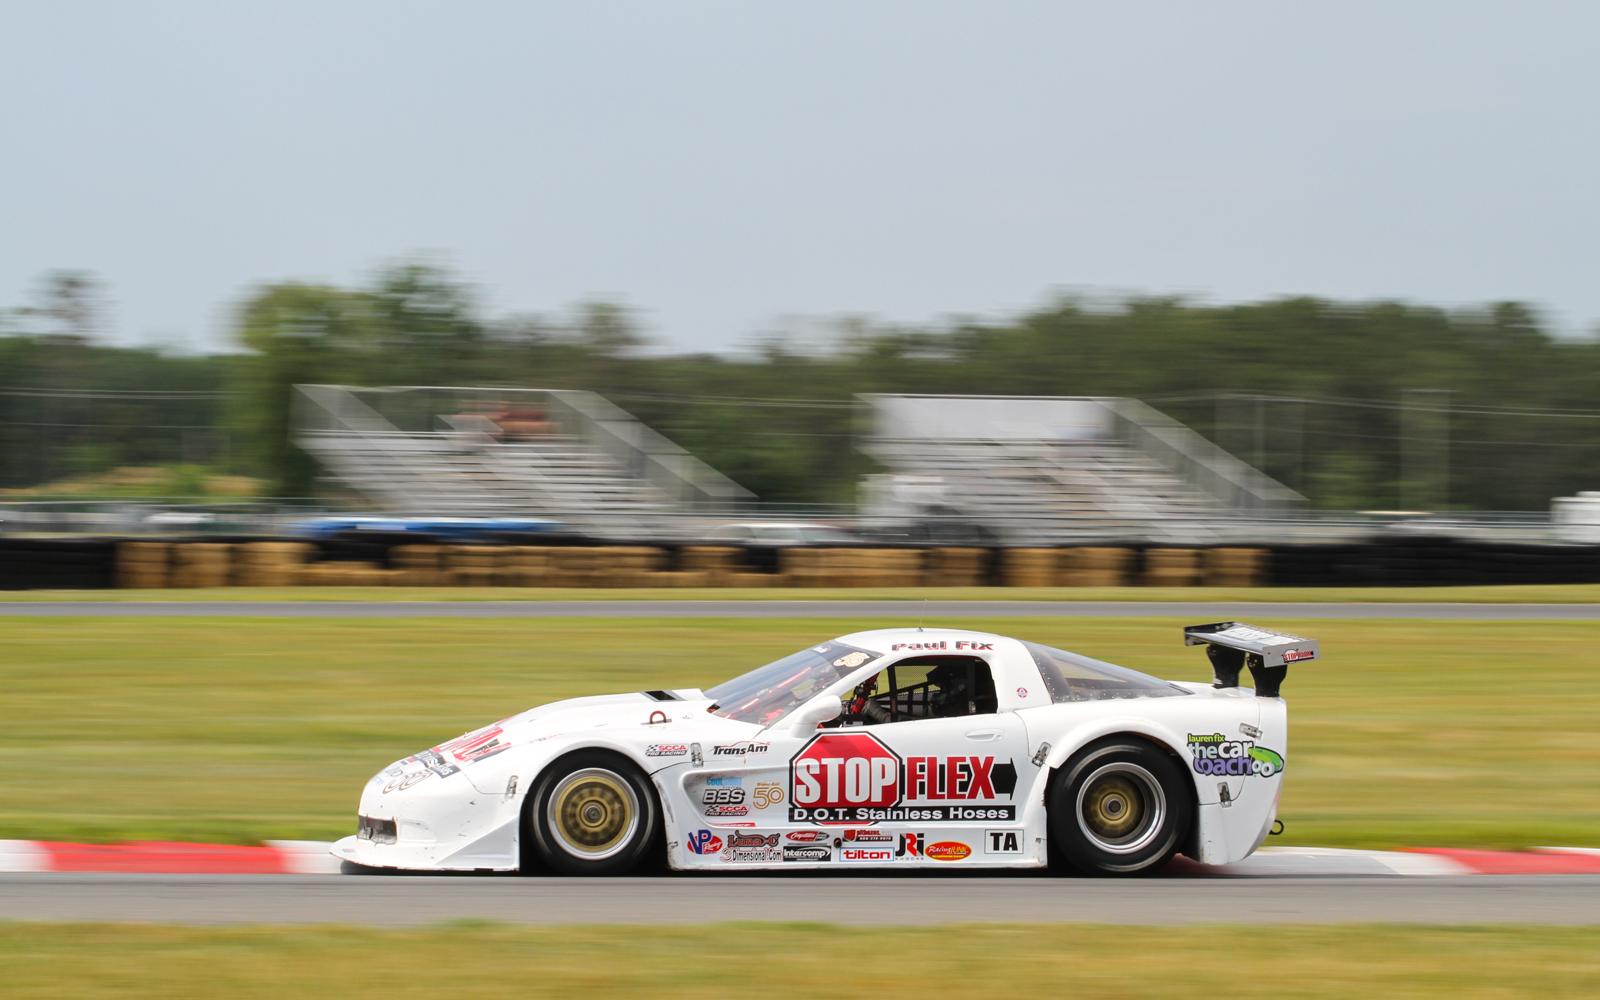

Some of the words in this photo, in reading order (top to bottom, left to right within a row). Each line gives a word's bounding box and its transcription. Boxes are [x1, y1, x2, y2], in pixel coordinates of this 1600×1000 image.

[891, 641, 947, 651] Paul
[955, 641, 994, 651] Fix
[1188, 733, 1214, 742] lauren
[1214, 733, 1226, 743] fix
[713, 745, 746, 755] Trans
[747, 743, 768, 753] Am
[1188, 743, 1218, 759] the
[1218, 740, 1254, 759] car
[1194, 757, 1254, 776] coach
[794, 757, 897, 804] STOP
[905, 755, 997, 801] FLEX
[703, 788, 746, 805] BBS
[752, 787, 785, 810] 50
[793, 808, 850, 821] D.O.T.
[855, 807, 943, 820] Stainless
[949, 807, 1009, 820] Hoses
[688, 829, 712, 855] VP
[989, 832, 1019, 852] TA
[783, 848, 826, 859] Intercomp
[843, 849, 891, 860] tilton
